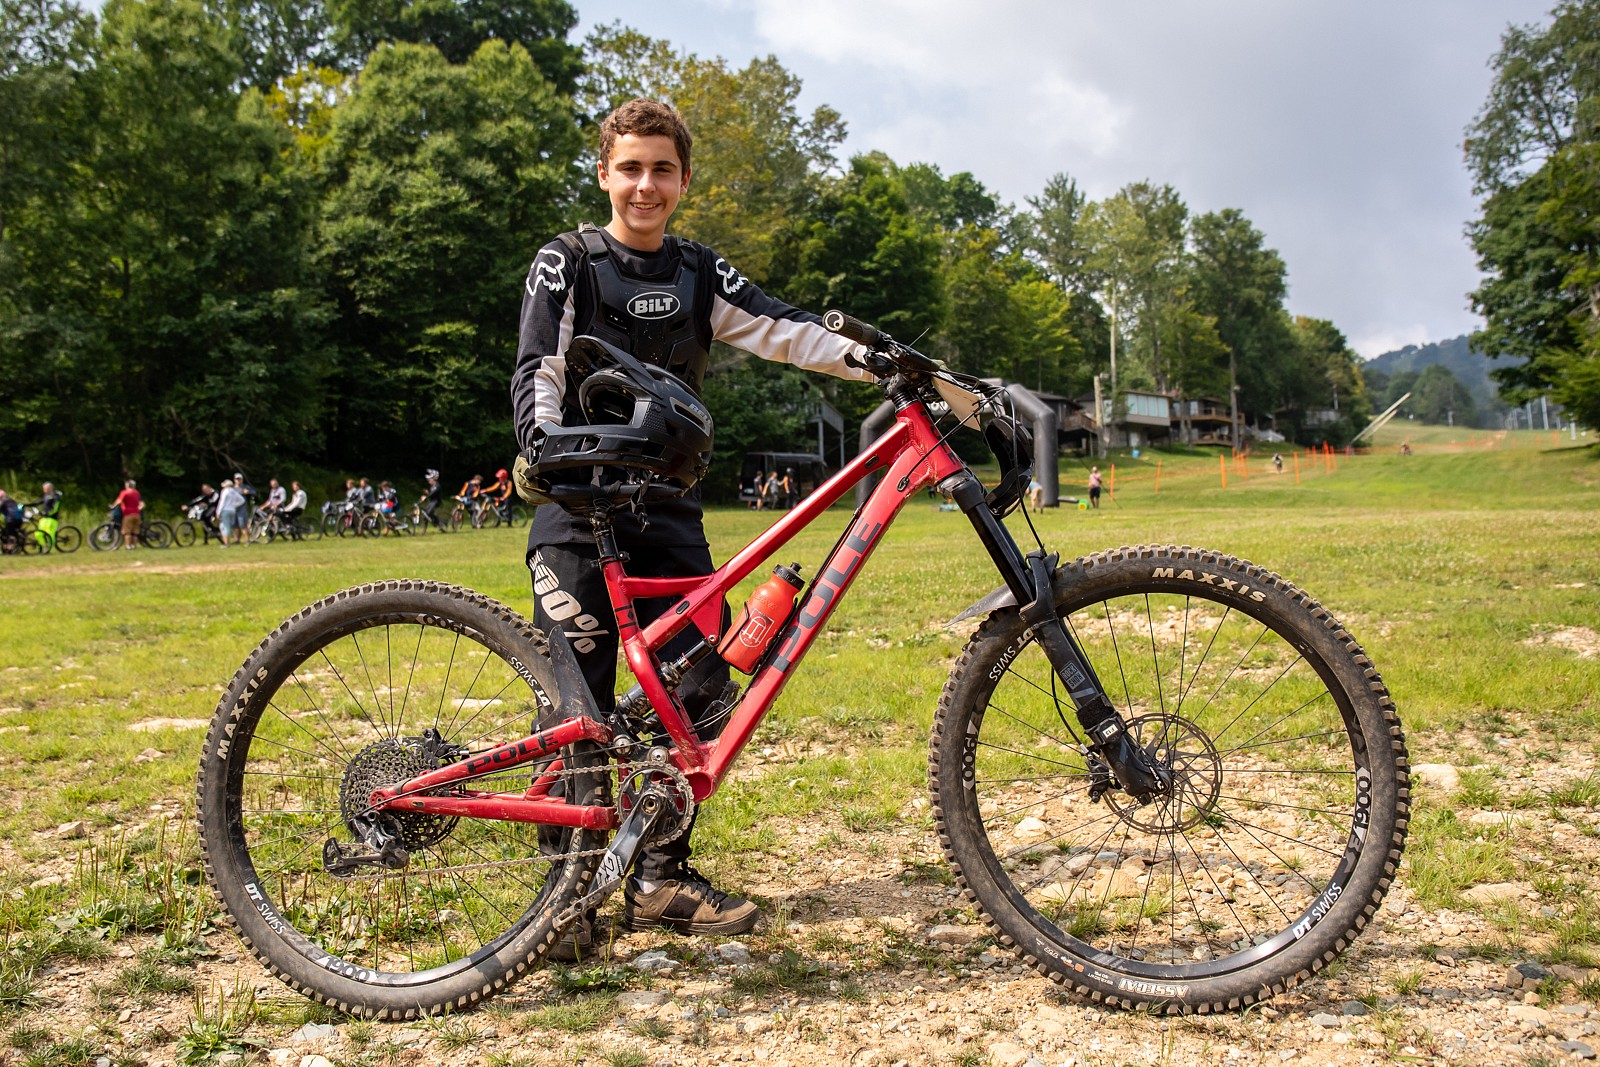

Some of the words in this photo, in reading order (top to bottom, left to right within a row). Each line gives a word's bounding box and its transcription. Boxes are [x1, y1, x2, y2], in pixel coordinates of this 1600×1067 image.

[634, 297, 673, 314] BiLT
[765, 517, 882, 673] POLE
[1151, 567, 1267, 602] MAXXIS
[1017, 628, 1034, 649] DT
[509, 656, 537, 687] SWISS
[989, 646, 1016, 681] SWISS
[1060, 664, 1077, 680] ROCK
[1066, 671, 1083, 687] SHOX
[217, 666, 268, 760] MAXXIS
[534, 689, 551, 707] DT
[467, 732, 559, 774] POLE
[1293, 916, 1312, 940] DT
[1312, 883, 1342, 921] SWISS
[1354, 776, 1371, 830] 1900
[245, 882, 263, 901] DT
[257, 903, 287, 935] SWISS
[1117, 977, 1189, 998] ASSEGAI
